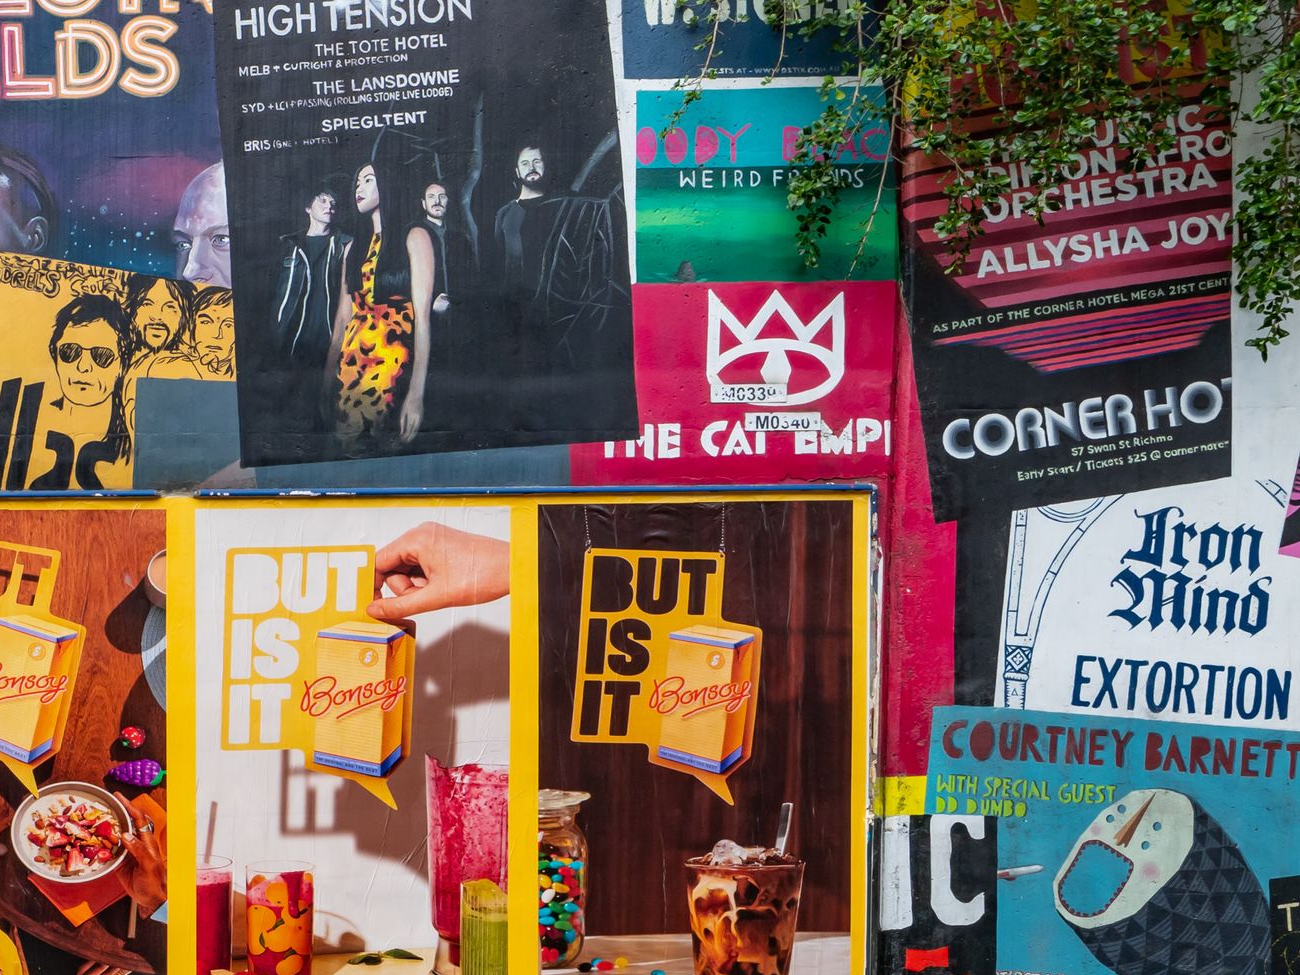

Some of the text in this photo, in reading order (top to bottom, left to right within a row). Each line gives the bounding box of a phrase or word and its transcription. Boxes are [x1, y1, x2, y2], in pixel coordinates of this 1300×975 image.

[235, 2, 316, 40] HIGH
[323, 0, 473, 32] TENSION
[238, 64, 270, 77] MELB
[344, 53, 408, 67] PROTECTION
[315, 33, 447, 57] THE TOTE HOTEL
[241, 102, 265, 114] SYD
[374, 91, 400, 102] STONE
[402, 89, 420, 100] LIVE
[312, 69, 460, 95] THE LANSDOWNE
[321, 110, 427, 132] SPIEGLTENT
[244, 139, 271, 152] BRIS
[679, 169, 761, 188] WEIRD
[977, 212, 1231, 279] ALLYSHA JOY
[932, 277, 1231, 334] AS PART OF THE CORNER HOTEL MEGA 21ST CENT
[942, 393, 1137, 460] CORNER
[1071, 446, 1084, 457] 57
[1087, 441, 1116, 455] Swan
[1118, 439, 1131, 450] St
[1127, 452, 1148, 465] $25
[1150, 449, 1161, 461] @
[1120, 506, 1264, 576] Iron
[232, 551, 368, 615] BUT
[589, 555, 717, 616] BUT
[1107, 566, 1273, 638] Mind
[230, 618, 300, 679] IS
[585, 618, 651, 677] IS
[300, 675, 407, 719] Bonsoy
[579, 679, 641, 737] IT
[649, 675, 752, 718] Bonsoy
[1071, 655, 1292, 721] EXTORTION
[228, 683, 291, 744] IT
[942, 720, 1300, 779] COURTNEY BARNETT
[936, 796, 958, 814] DD
[937, 774, 1116, 804] WITH SPECIAL GUEST
